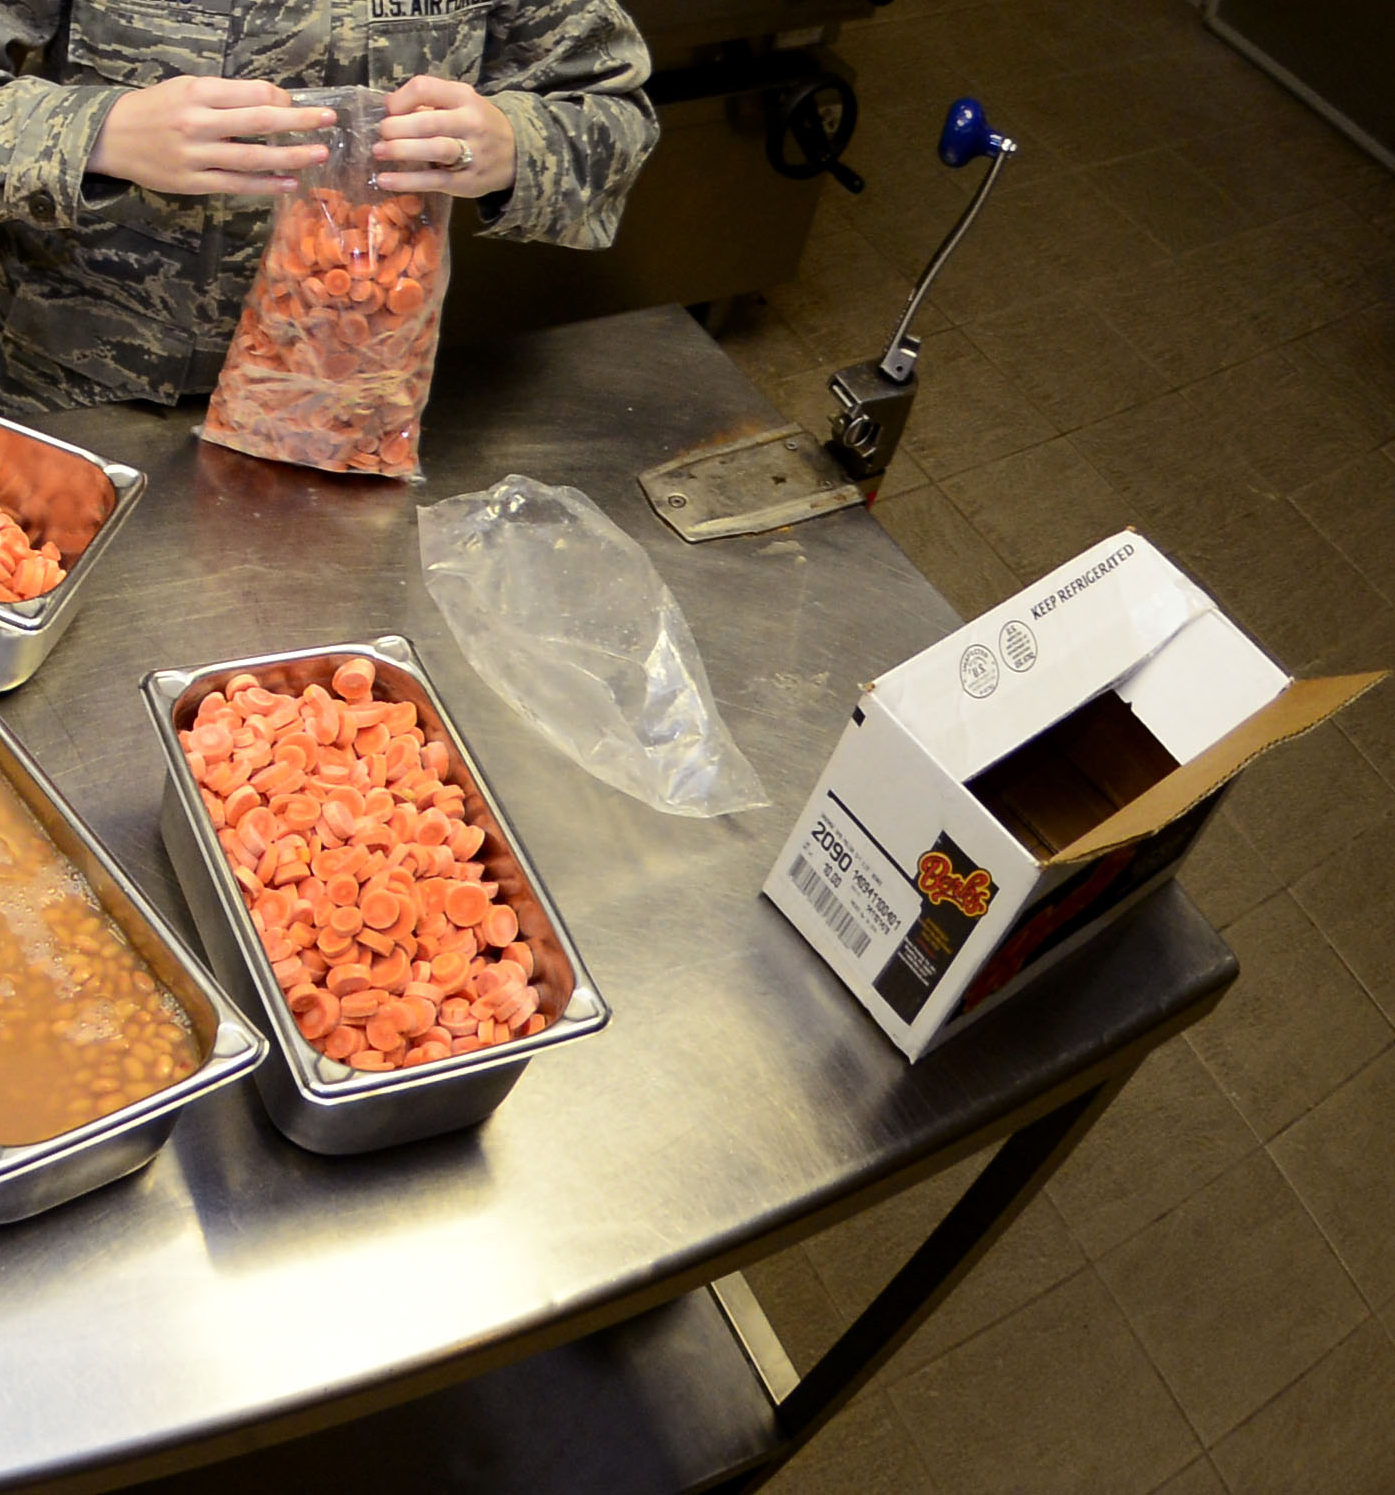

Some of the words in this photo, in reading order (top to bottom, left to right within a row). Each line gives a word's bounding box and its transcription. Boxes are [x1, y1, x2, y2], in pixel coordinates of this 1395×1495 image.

[1030, 595, 1057, 620] KEEP
[1056, 544, 1135, 603] REFRIGERATED
[811, 821, 852, 873] 2090
